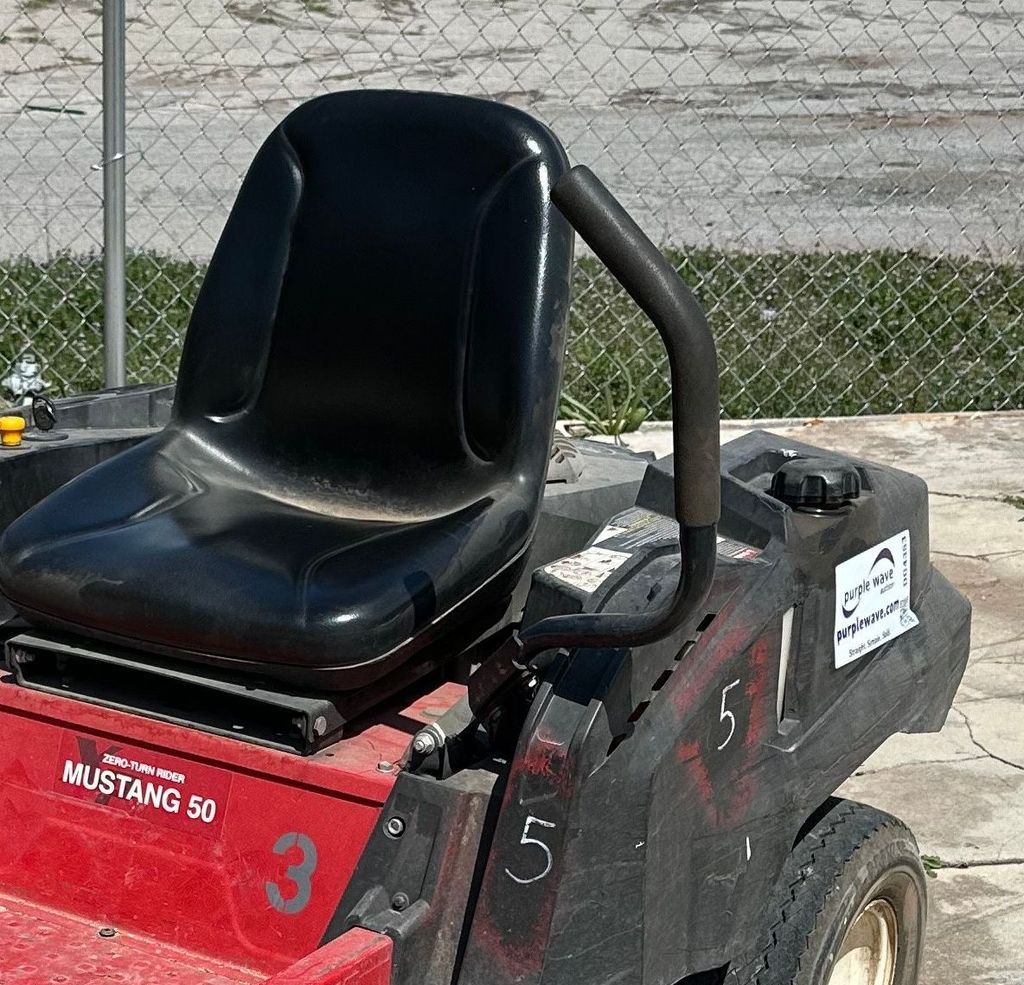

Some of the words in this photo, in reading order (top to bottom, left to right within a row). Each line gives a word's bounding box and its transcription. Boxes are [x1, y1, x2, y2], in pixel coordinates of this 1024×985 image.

[844, 579, 871, 605] purple
[873, 568, 894, 588] wave
[837, 599, 899, 646] purplewave.com
[718, 678, 740, 750] 5
[62, 759, 182, 814] MUSTANG
[186, 794, 217, 823] 50
[102, 753, 156, 776] ZERO-TURN
[156, 768, 186, 784] RIDER
[265, 831, 318, 915] 3
[504, 815, 557, 884] 5
